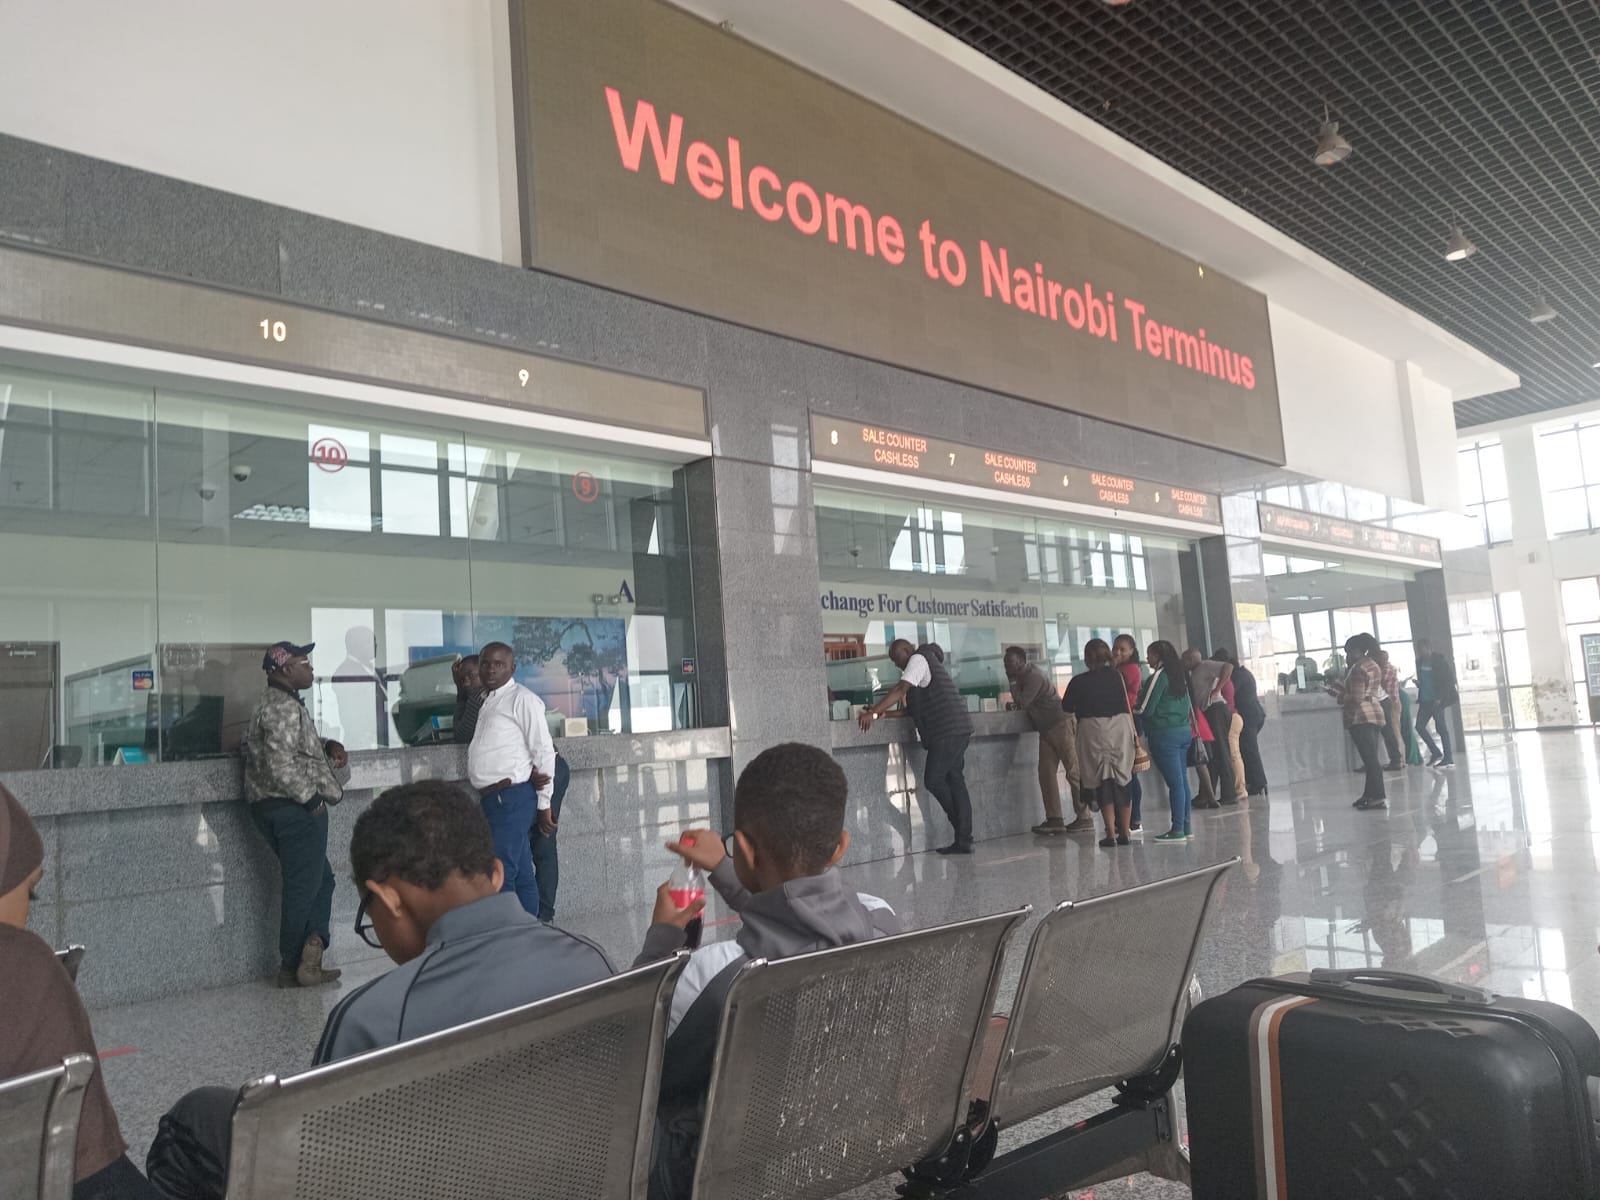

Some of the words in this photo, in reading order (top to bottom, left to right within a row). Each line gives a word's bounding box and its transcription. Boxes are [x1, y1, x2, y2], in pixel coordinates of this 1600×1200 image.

[605, 86, 905, 265] Welcome
[919, 219, 967, 286] to
[980, 240, 1118, 341] Nairobi
[1125, 298, 1255, 389] Terminus
[260, 318, 287, 342] 10
[518, 369, 529, 387] 9
[831, 430, 838, 445] 8
[863, 428, 886, 443] SALE
[887, 433, 927, 452] COUNTER
[317, 446, 341, 464] 10
[875, 449, 919, 469] CASHLESS
[949, 454, 956, 466] 7
[985, 453, 1003, 468] SALE
[1004, 457, 1037, 474] COUNTER
[994, 471, 1031, 488] CASHLESS
[1063, 475, 1068, 487] 6
[1091, 474, 1107, 485] SALE
[1107, 477, 1134, 491] COUNTER
[1099, 490, 1129, 504] CASHLESS
[619, 579, 634, 603] A
[877, 593, 902, 613] For
[905, 594, 970, 616] Customer
[971, 599, 1039, 618] Satisfaction
